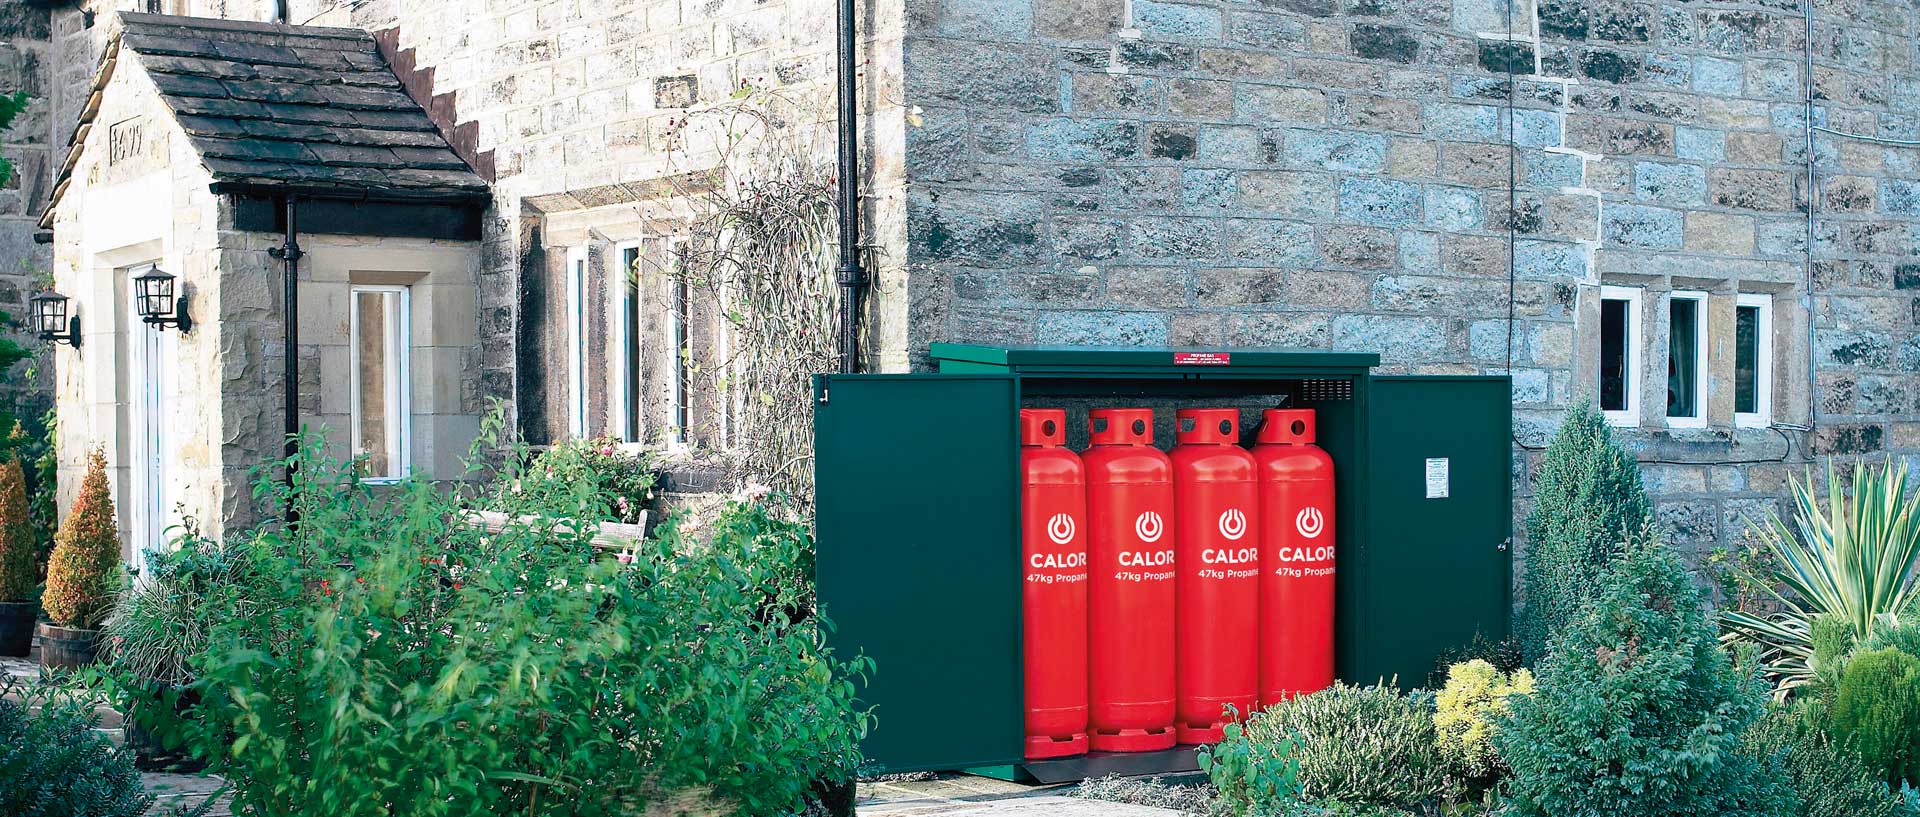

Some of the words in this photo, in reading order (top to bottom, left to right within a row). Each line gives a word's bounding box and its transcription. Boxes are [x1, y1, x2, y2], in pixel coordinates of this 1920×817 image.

[1030, 552, 1087, 568] CALOR
[1118, 550, 1175, 566] CALOR
[1201, 547, 1258, 564] CALOR
[1279, 545, 1335, 562] CALOR
[1027, 573, 1053, 584] 47kg
[1115, 571, 1140, 582] 47kg
[1198, 569, 1224, 579] 47kg
[1275, 567, 1301, 577] 47kg
